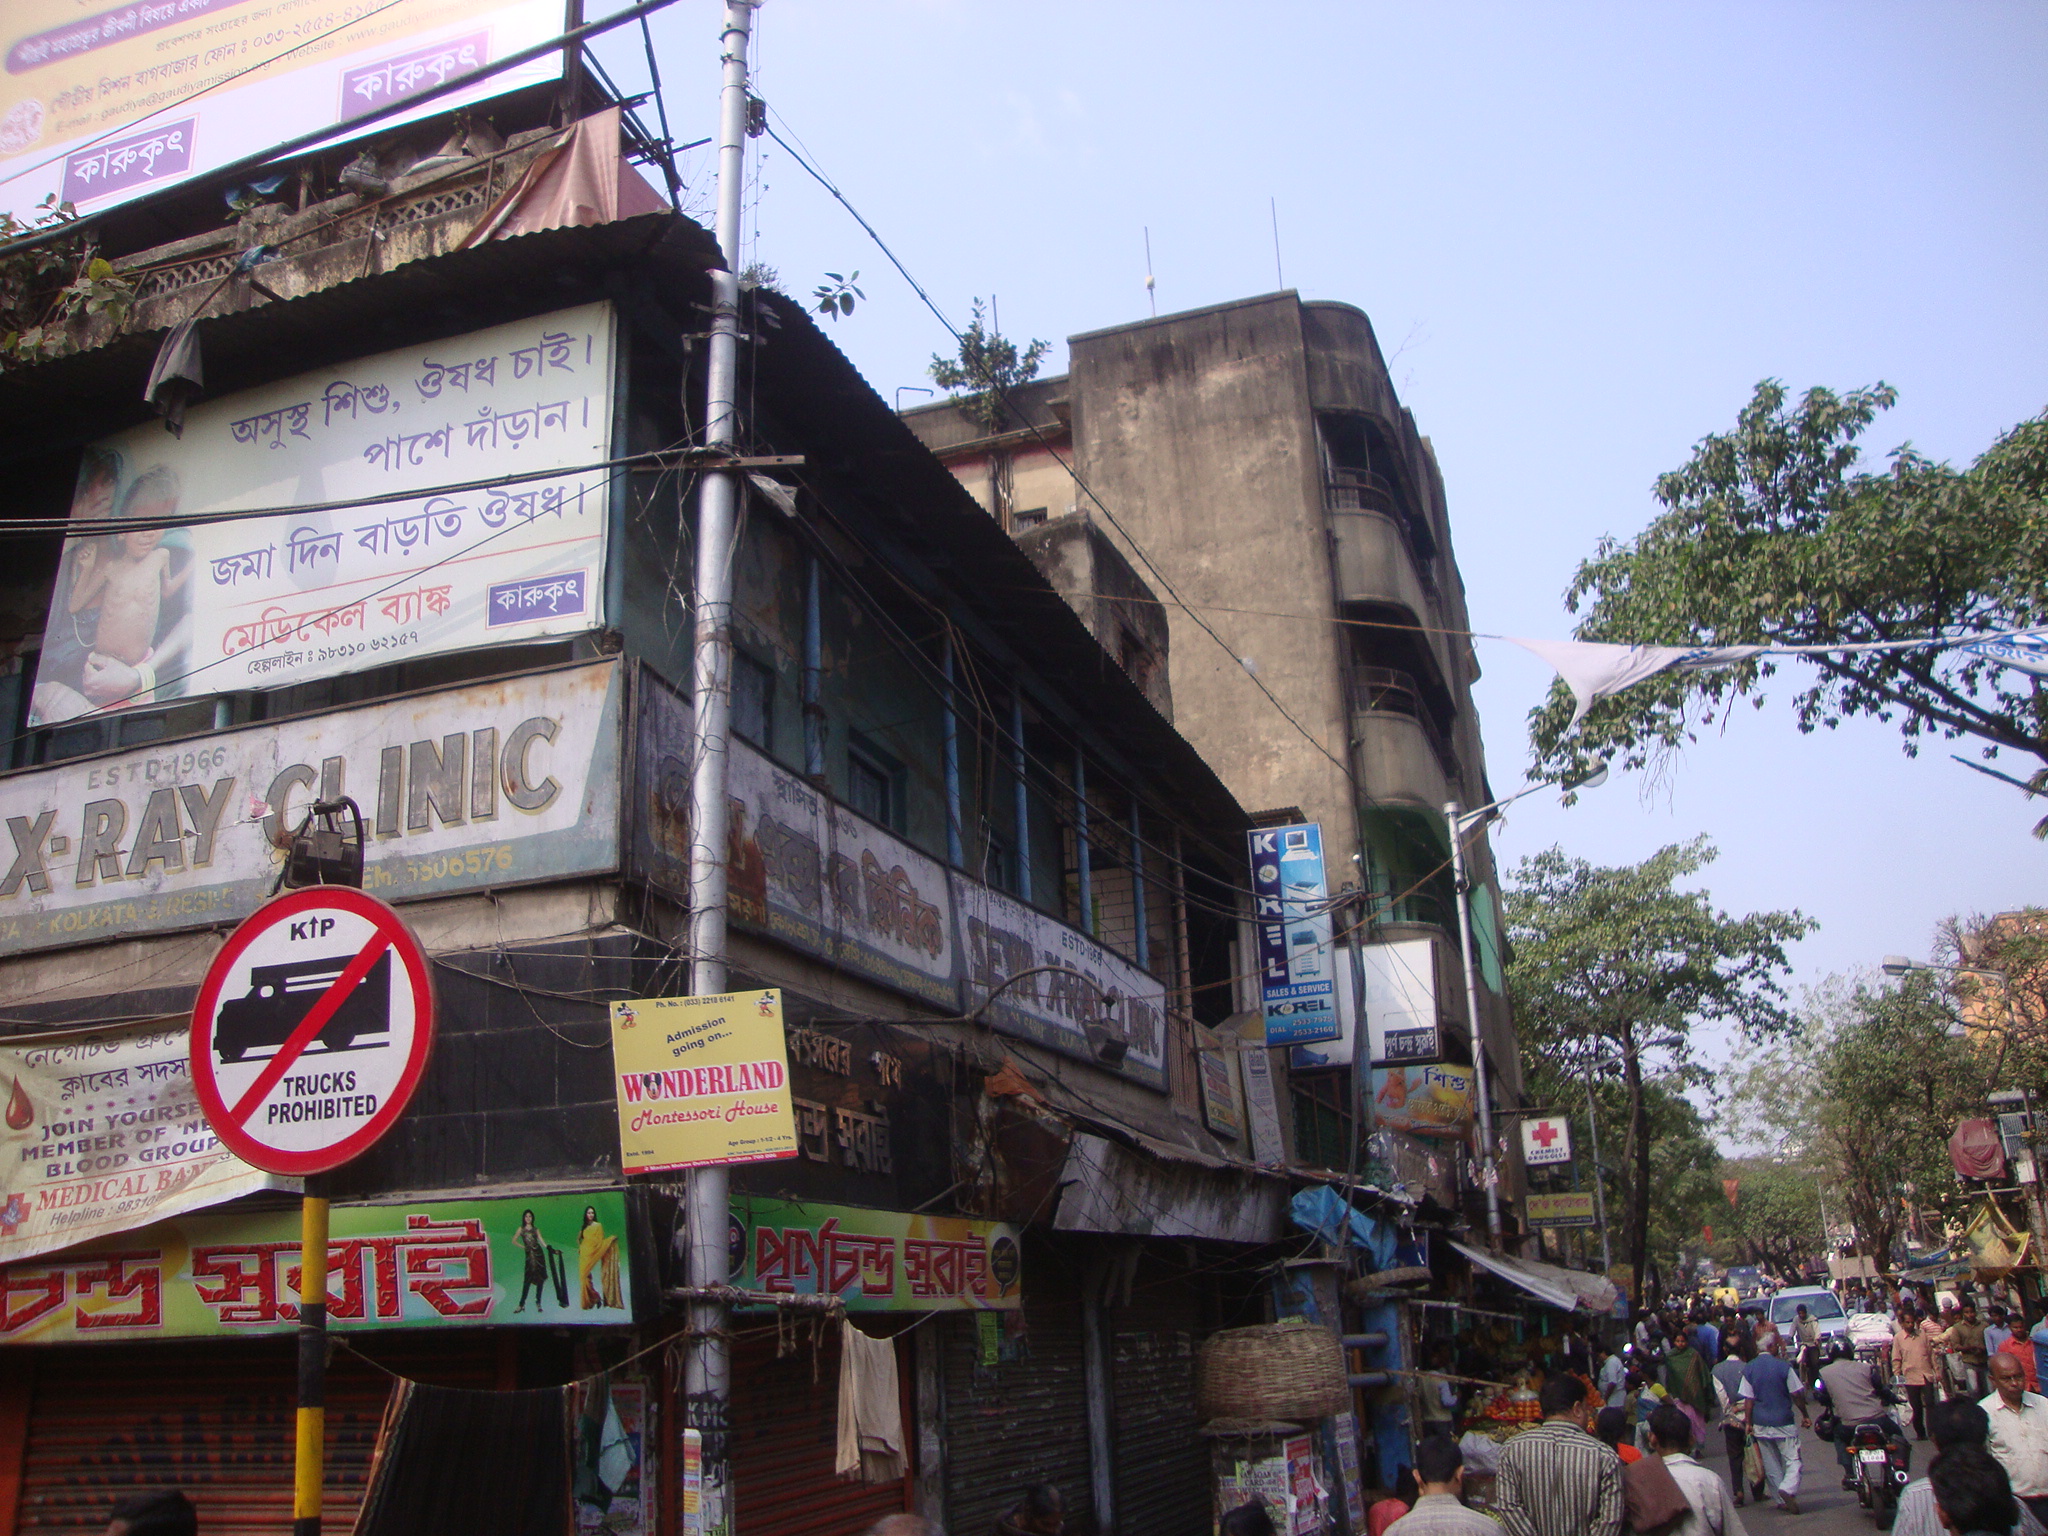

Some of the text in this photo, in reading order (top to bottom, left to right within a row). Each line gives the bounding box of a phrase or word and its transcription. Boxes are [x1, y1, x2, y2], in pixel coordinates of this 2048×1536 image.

[135, 54, 199, 86] বাগবাজার
[203, 41, 236, 66] ফোন
[74, 130, 184, 184] কারুকৃৎ
[230, 401, 312, 450] অসুস্থ
[320, 380, 400, 427] শিশু,
[414, 357, 499, 399] ঔষধ
[362, 422, 454, 472] পাশে
[210, 542, 277, 586] জমা
[286, 526, 344, 575] দিন
[354, 497, 468, 557] বাড়তি
[496, 577, 580, 613] কারুকৃৎ
[222, 599, 368, 656] মেডিকেল
[247, 650, 304, 676] হেল্পলাইন
[0, 776, 240, 898] X-RAY
[263, 716, 563, 850] CLINIC
[1267, 988, 1290, 999] SALES
[1298, 982, 1331, 995] SERVICE
[1268, 999, 1331, 1017] KOREL
[666, 1016, 726, 1044] Admission
[1270, 1026, 1287, 1034] DIAL
[672, 1039, 705, 1057] going
[283, 1070, 357, 1098] TRUCKS
[622, 1060, 784, 1103] WONDERLAND
[267, 1094, 378, 1125] PROHIBITED
[631, 1099, 779, 1132] Montessori House
[21, 1134, 125, 1162] MEMBER
[135, 1126, 167, 1145] OF
[42, 1118, 94, 1142] JOIN
[46, 1153, 130, 1178] BLOOD
[36, 1170, 150, 1211] MEDICAL
[50, 1205, 105, 1227] Helpline
